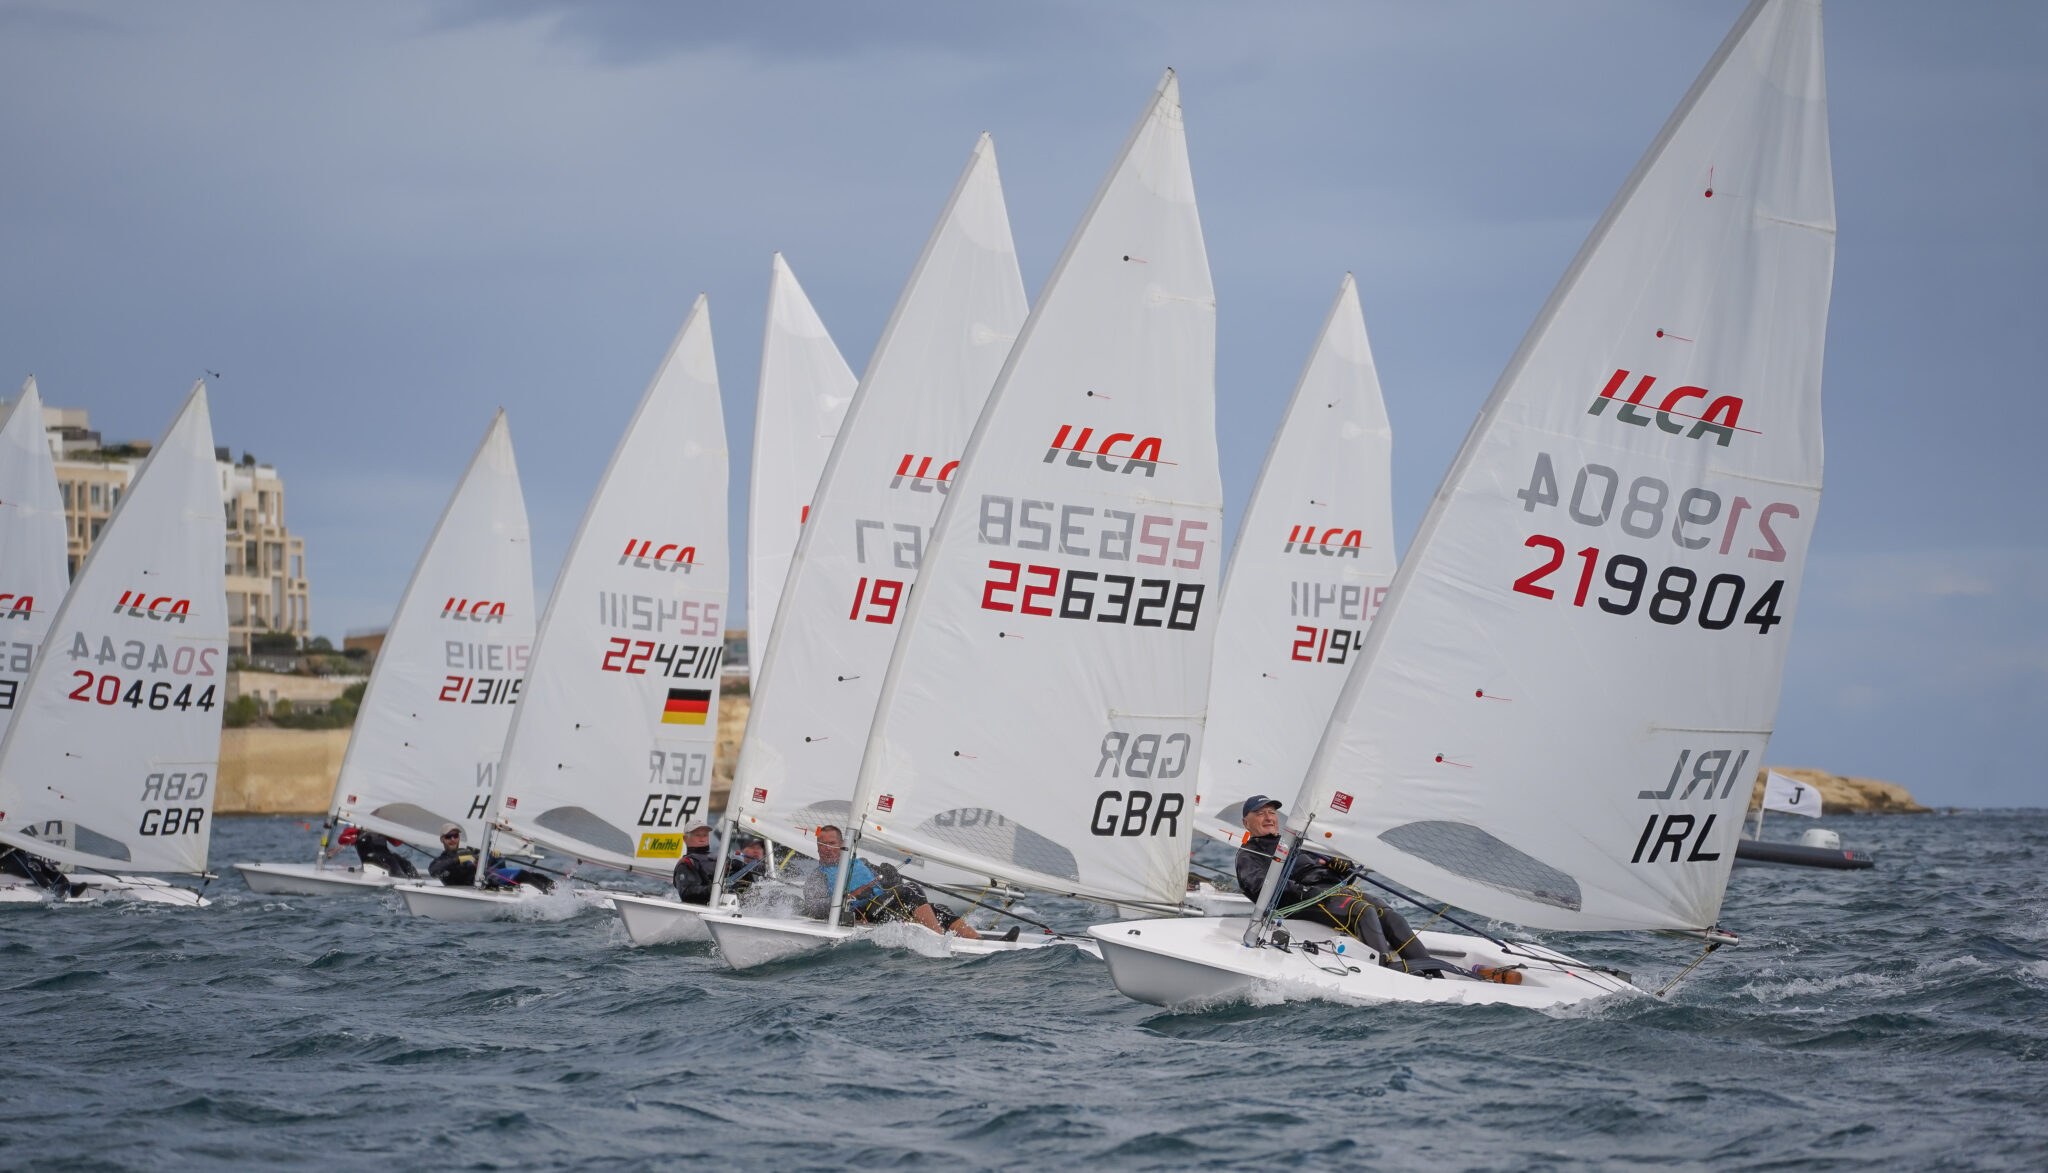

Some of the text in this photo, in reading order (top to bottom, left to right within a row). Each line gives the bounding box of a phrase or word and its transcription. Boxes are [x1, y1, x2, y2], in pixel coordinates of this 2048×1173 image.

[1587, 369, 1743, 447] ILCA
[1043, 424, 1162, 477] ILCA
[889, 454, 960, 495] ILC
[618, 538, 695, 574] ILCA
[1284, 525, 1362, 558] ILCA
[849, 577, 914, 624] 19
[981, 560, 1205, 631] 226328
[1513, 534, 1784, 634] 219804
[0, 594, 33, 621] CA
[113, 591, 190, 623] ILCA
[440, 597, 505, 624] ILCA
[69, 670, 215, 712] 204644
[637, 794, 701, 827] GER
[1091, 791, 1184, 837] GBR
[1789, 787, 1805, 805] J
[139, 808, 204, 836] GBR
[1631, 814, 1720, 863] IRL
